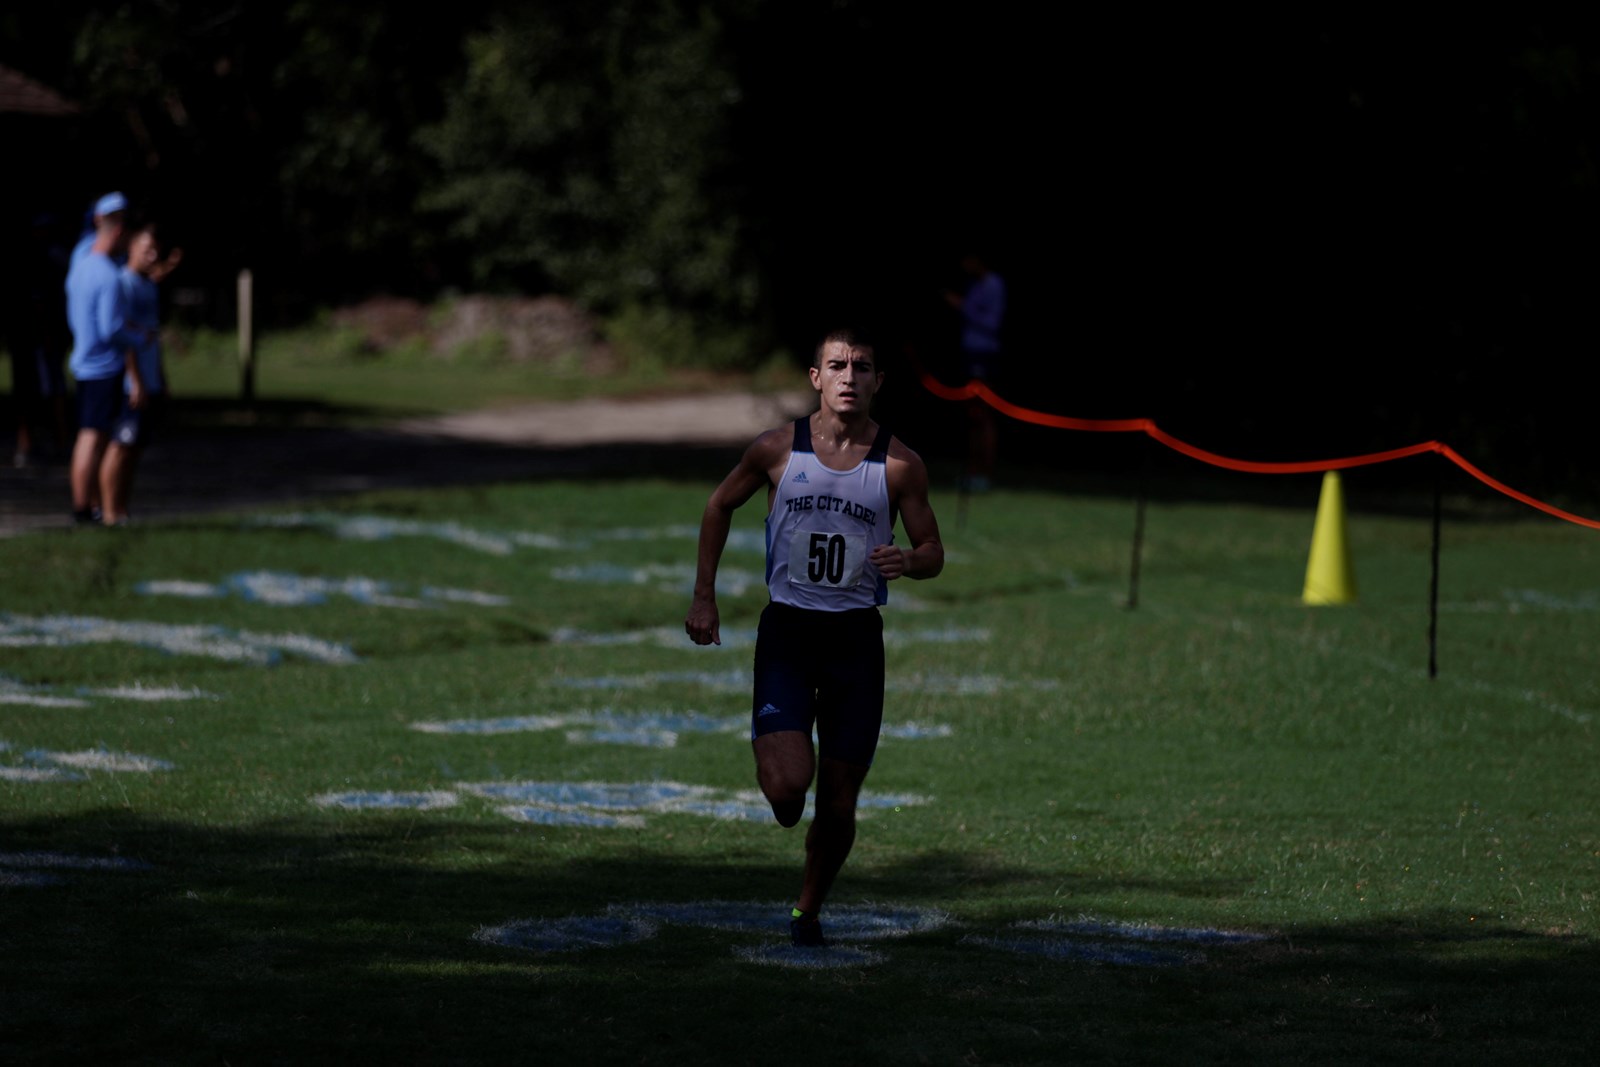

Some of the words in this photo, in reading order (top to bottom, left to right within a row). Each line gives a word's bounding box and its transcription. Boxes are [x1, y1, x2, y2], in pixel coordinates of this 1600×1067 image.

[786, 496, 813, 512] THE
[817, 496, 876, 526] CITADEL
[808, 533, 845, 584] 50
